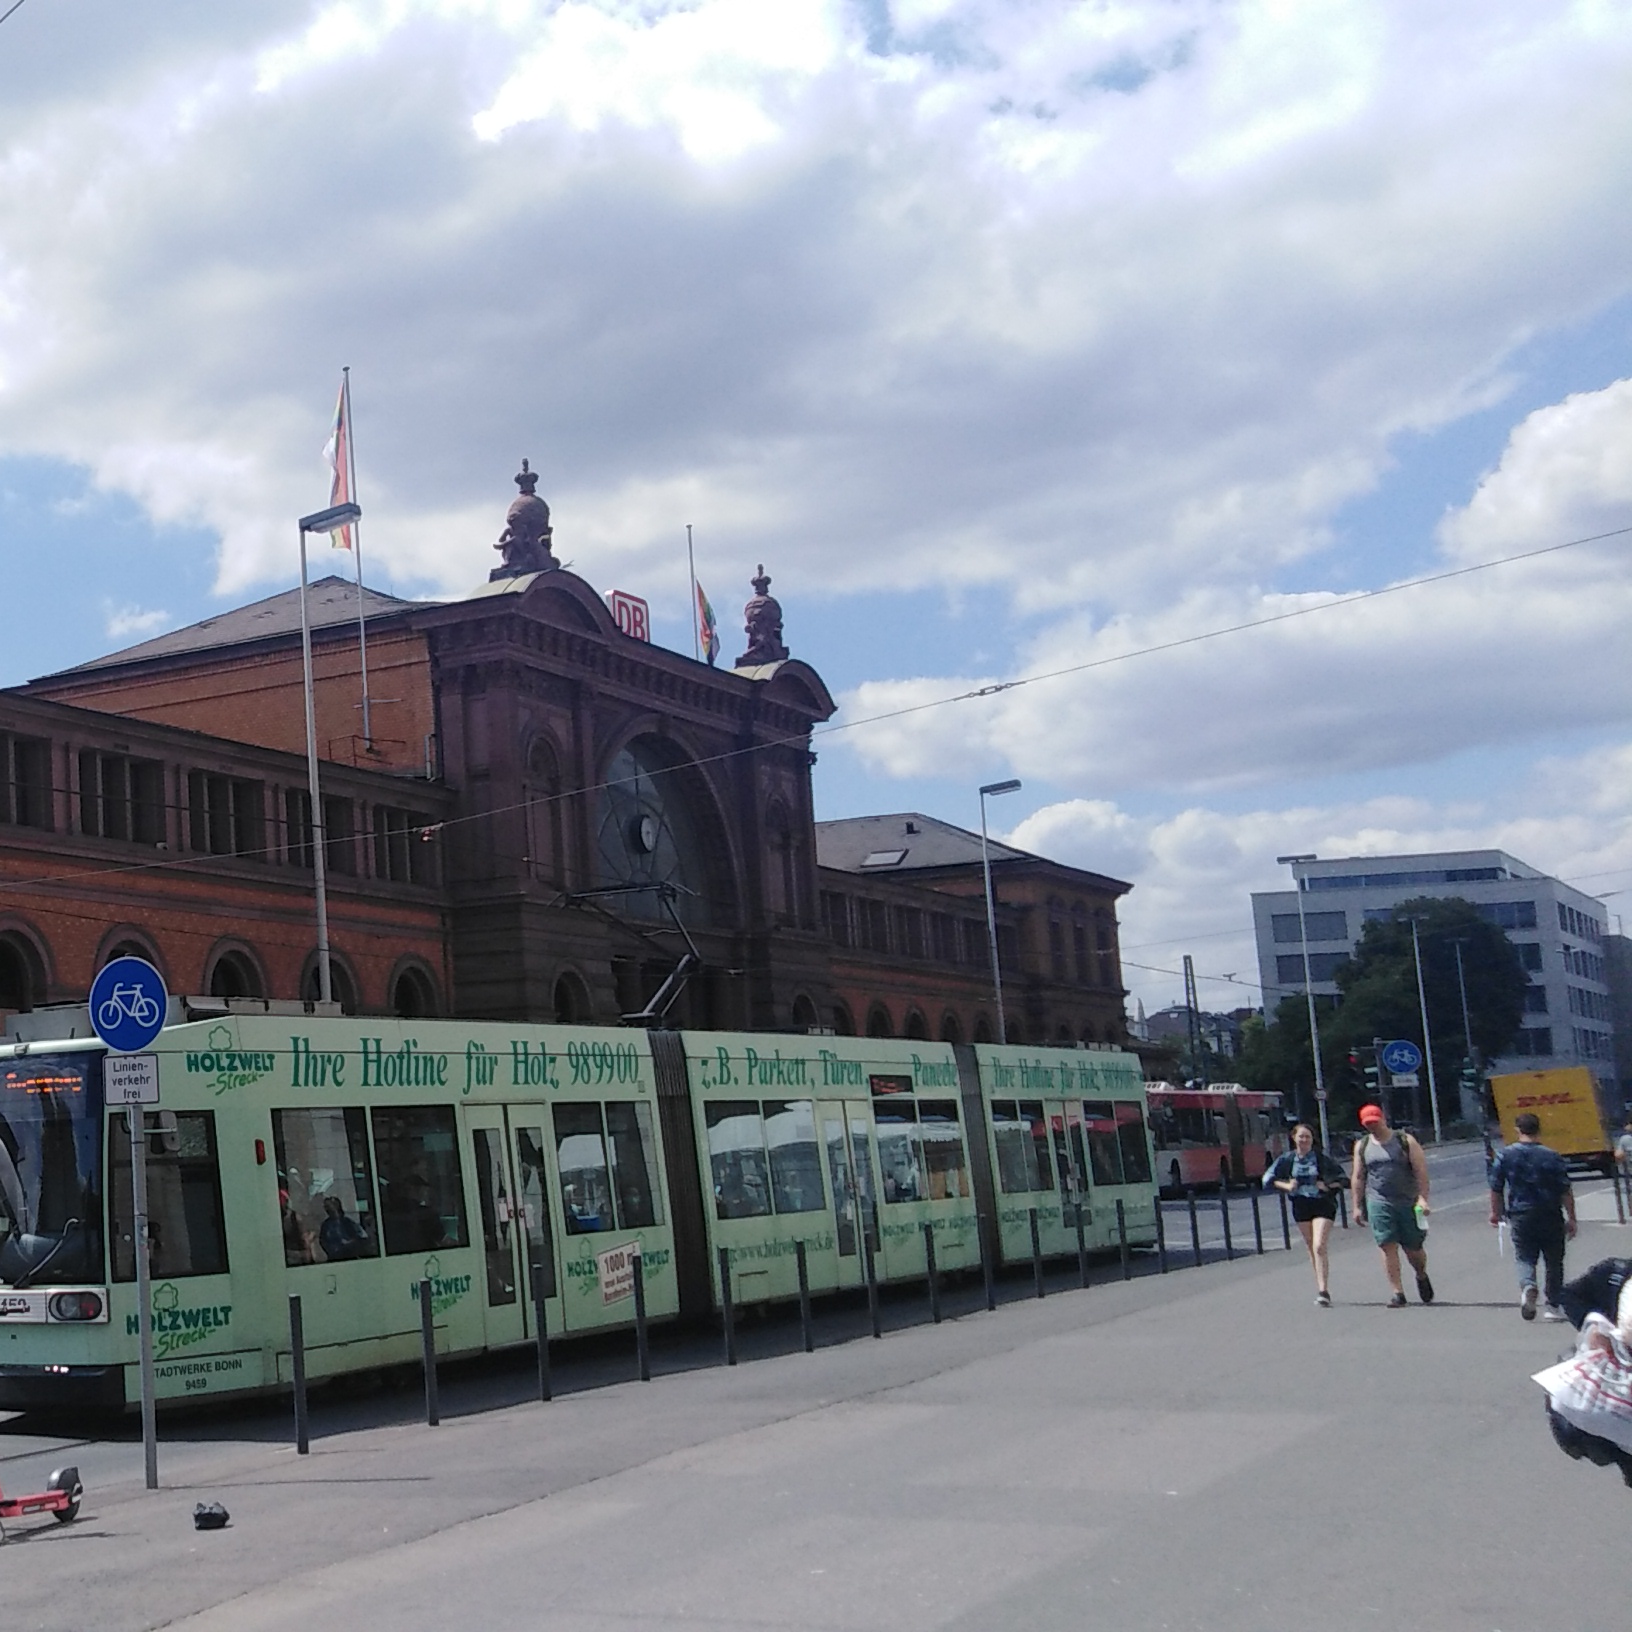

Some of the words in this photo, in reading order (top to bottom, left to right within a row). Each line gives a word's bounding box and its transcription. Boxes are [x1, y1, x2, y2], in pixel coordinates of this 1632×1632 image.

[617, 600, 645, 643] DB
[112, 1060, 149, 1073] Linien-
[186, 1052, 275, 1073] HOLZWELT
[289, 1036, 345, 1088] Ihre
[359, 1037, 449, 1087] Hotline
[462, 1039, 499, 1095] für
[510, 1040, 559, 1090] Holz
[567, 1040, 640, 1086] 989900
[701, 1046, 738, 1090] z.B.
[745, 1047, 815, 1090] Parkett,
[111, 1073, 152, 1086] verkehr
[123, 1087, 141, 1100] frei
[154, 1362, 213, 1379] TADTWERKE
[214, 1359, 243, 1372] BONN
[185, 1378, 207, 1391] 9459
